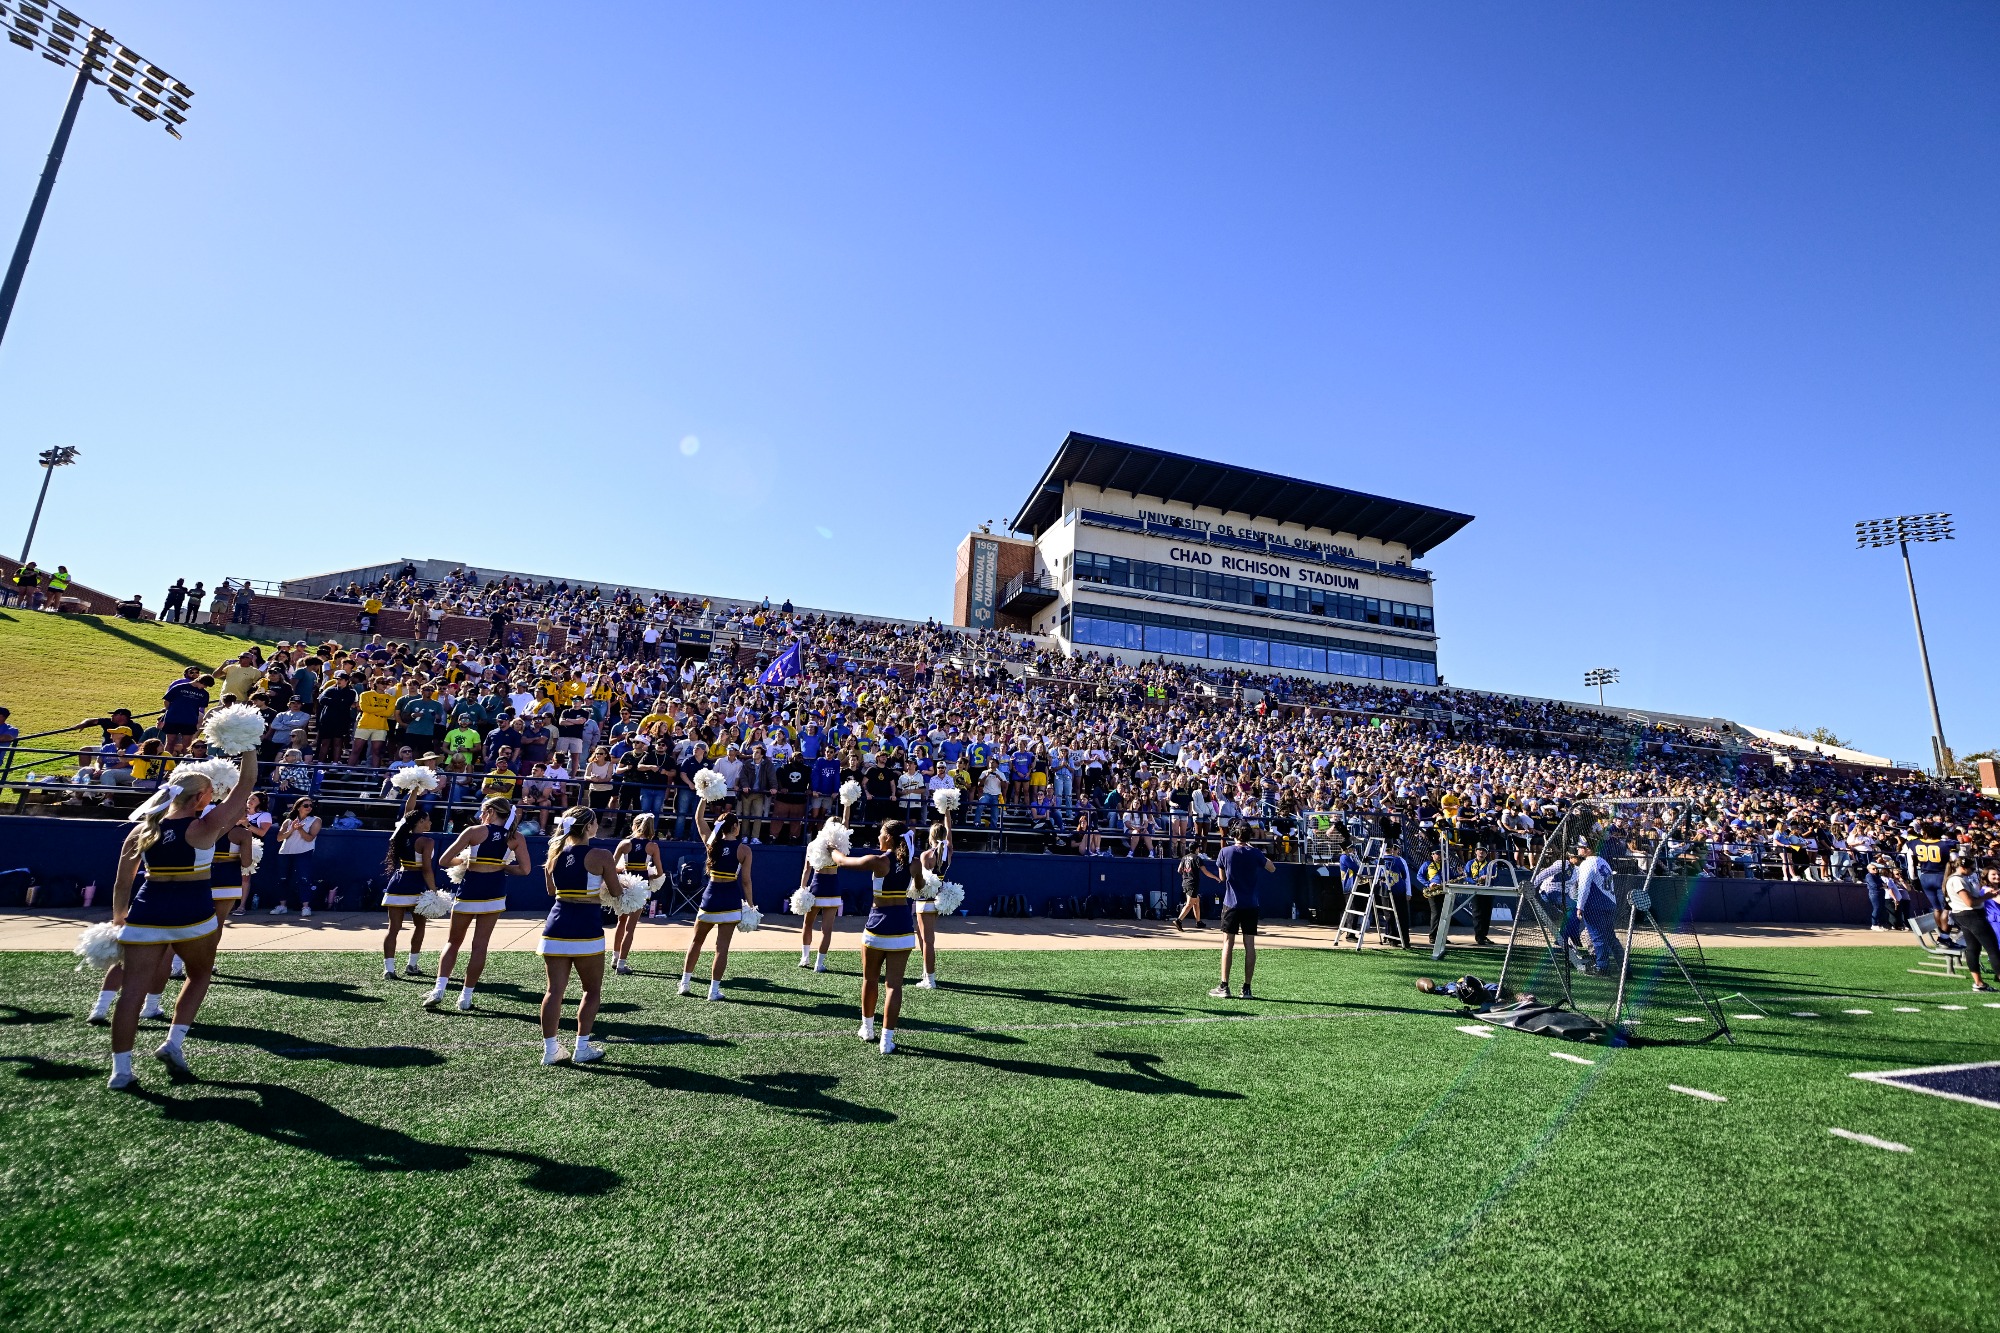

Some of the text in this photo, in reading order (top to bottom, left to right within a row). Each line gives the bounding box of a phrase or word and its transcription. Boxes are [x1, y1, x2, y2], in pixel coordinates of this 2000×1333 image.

[1138, 510, 1211, 531] UNIVERSITY
[1218, 524, 1233, 536] OF
[1239, 528, 1289, 545] CENTRAL
[976, 542, 998, 551] 1962
[975, 554, 985, 603] NATIONAL
[984, 551, 995, 607] CHAMPIONS
[1170, 547, 1359, 590] CHAD RICHISON STADIUM
[974, 747, 984, 764] S
[1916, 845, 1941, 862] 90
